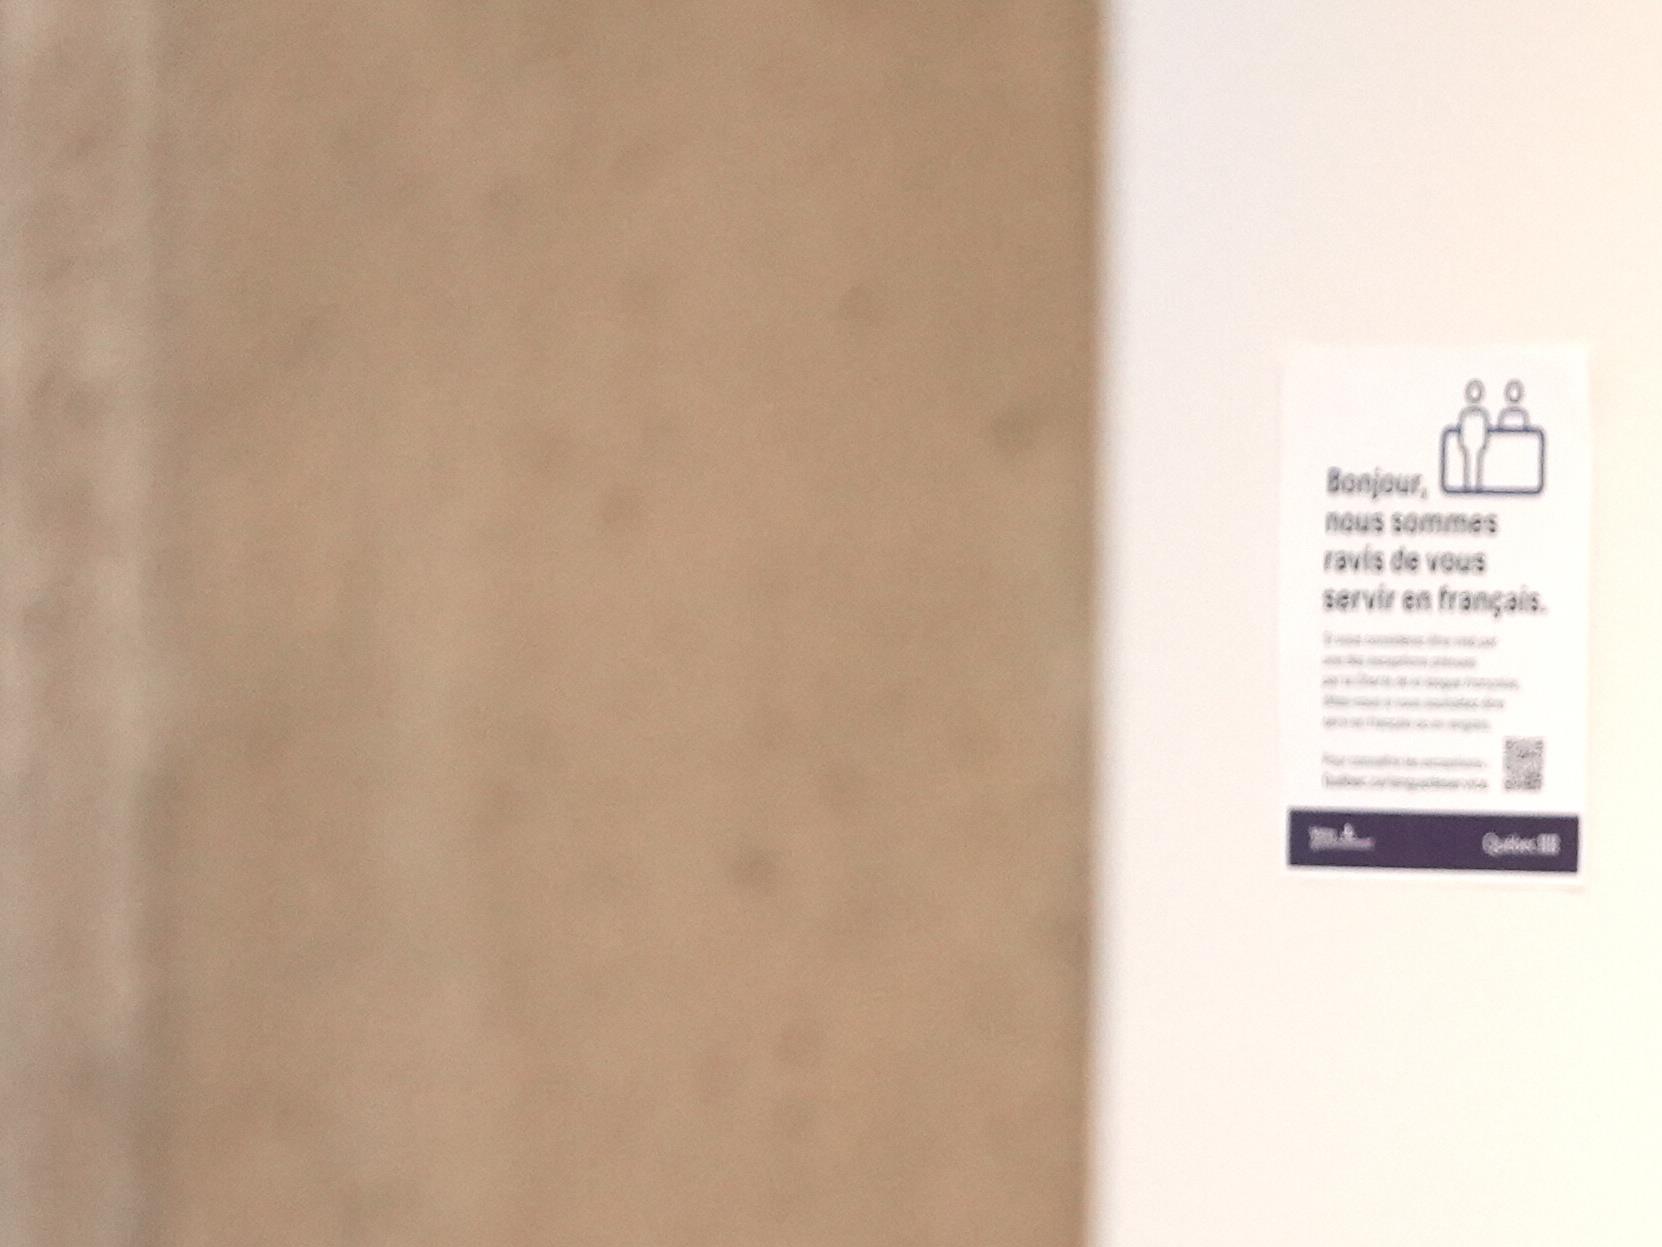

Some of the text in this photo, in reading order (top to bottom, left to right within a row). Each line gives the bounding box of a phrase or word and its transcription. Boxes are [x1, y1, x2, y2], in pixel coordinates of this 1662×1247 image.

[1327, 466, 1429, 501] Bonjour,
[1325, 510, 1498, 536] nous sommes
[1324, 545, 1486, 573] ravis de vous
[1323, 582, 1549, 618] servir en français.
